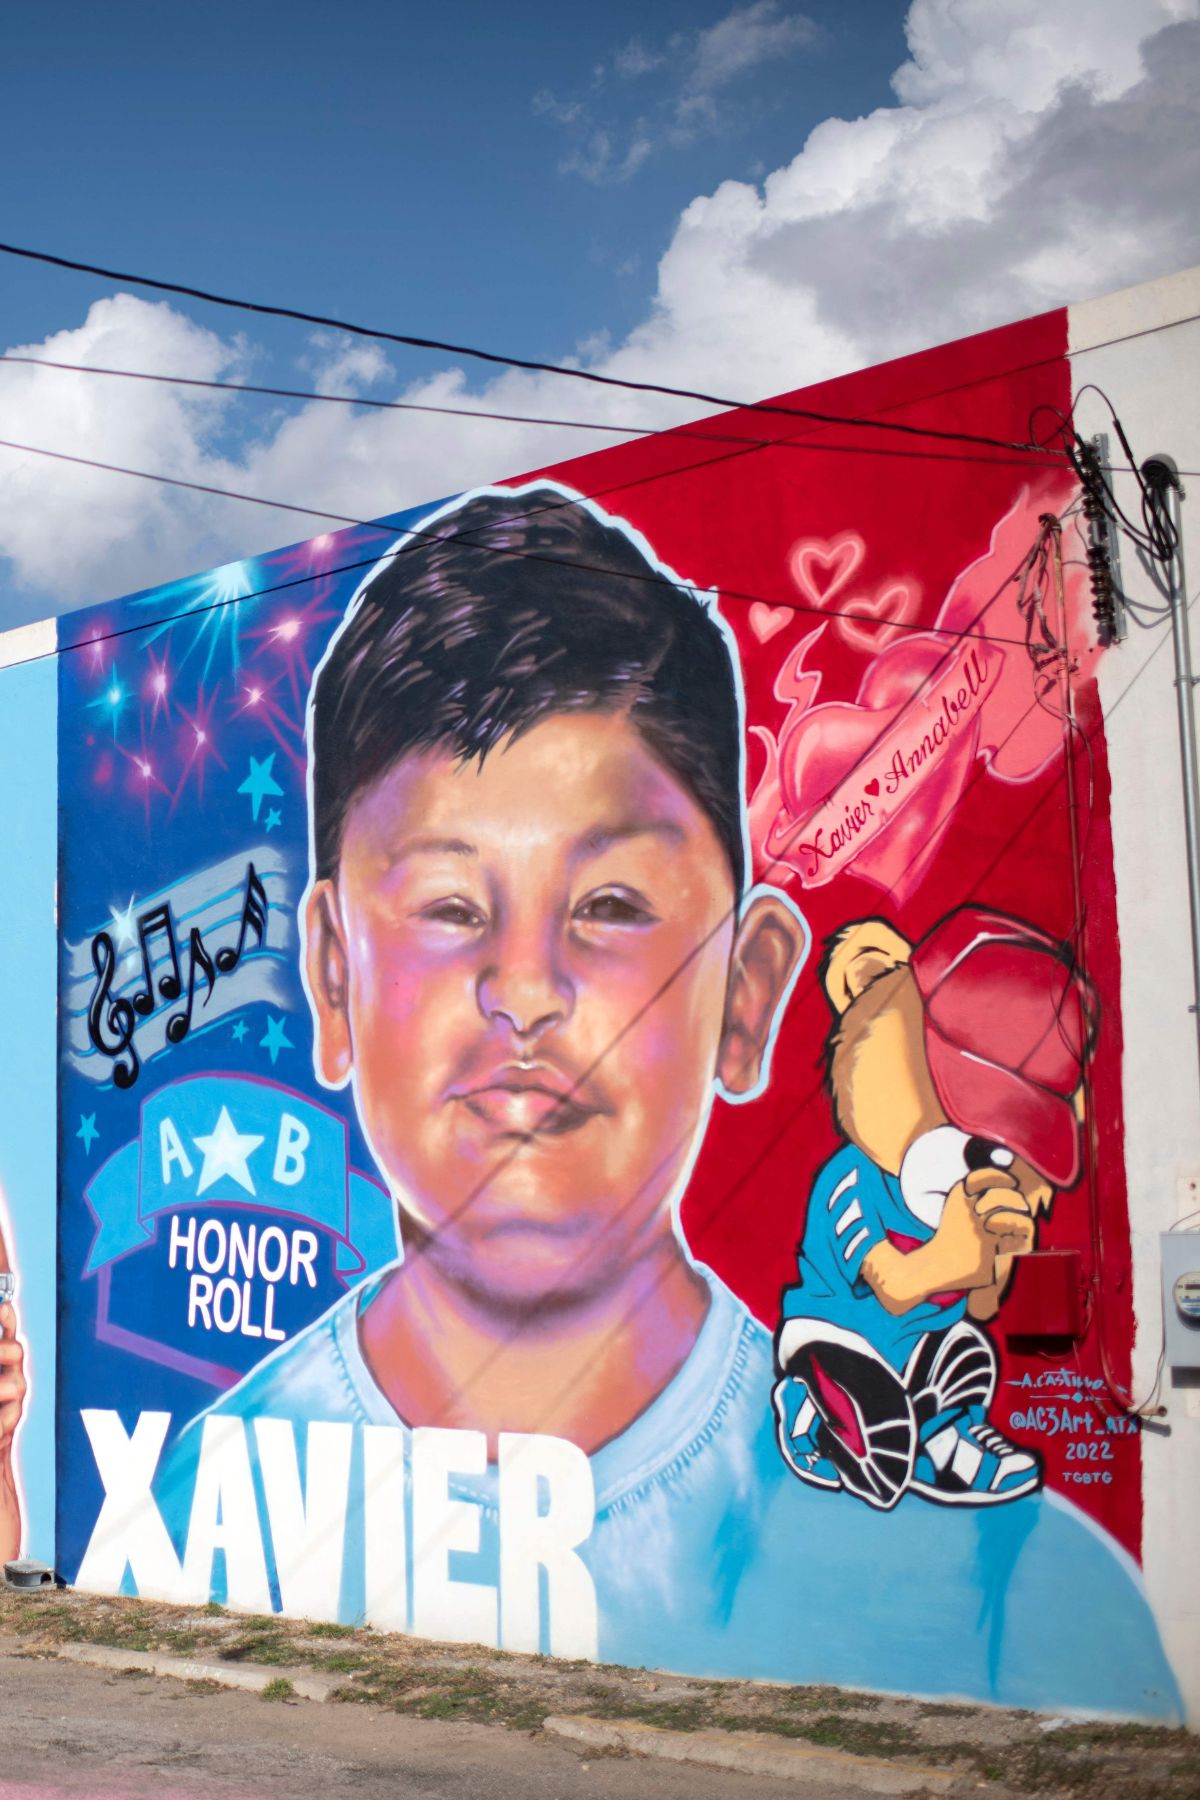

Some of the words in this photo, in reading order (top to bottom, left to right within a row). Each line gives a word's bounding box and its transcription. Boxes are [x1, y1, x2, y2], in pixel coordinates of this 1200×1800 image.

[798, 799, 875, 877] Xavier
[884, 649, 988, 794] Annabell
[159, 1117, 194, 1185] A
[272, 1112, 311, 1186] B
[168, 1214, 319, 1289] HONOR
[187, 1273, 287, 1342] ROLL
[1065, 1441, 1115, 1461] 2022
[73, 1408, 598, 1664] XAVIER
